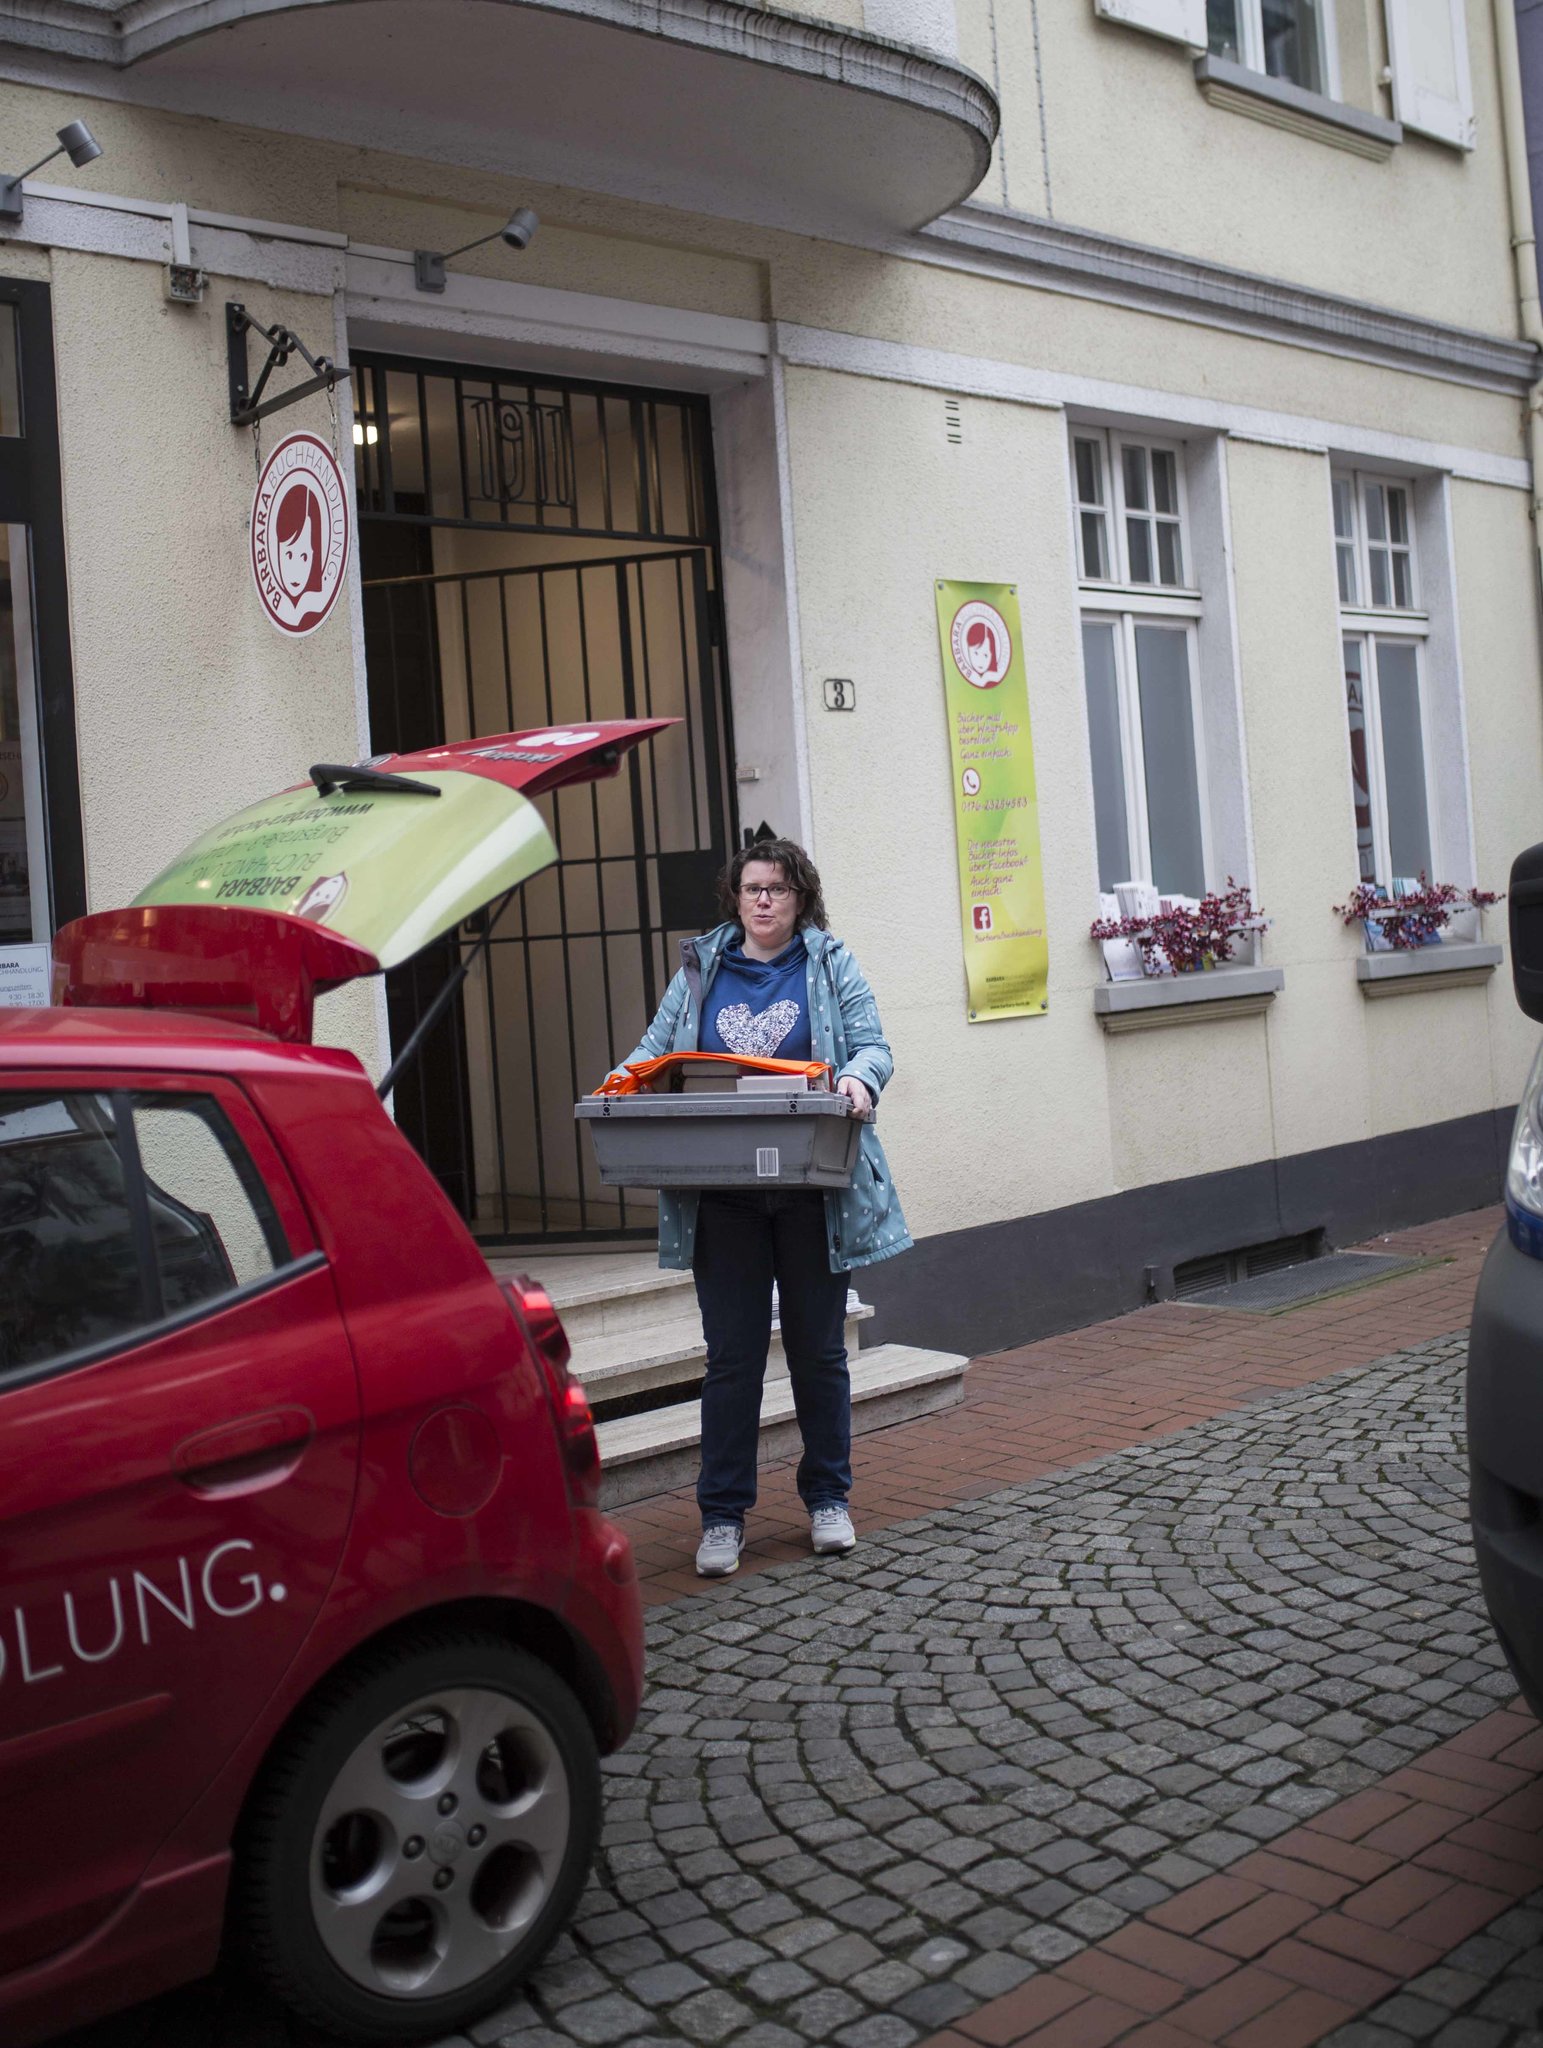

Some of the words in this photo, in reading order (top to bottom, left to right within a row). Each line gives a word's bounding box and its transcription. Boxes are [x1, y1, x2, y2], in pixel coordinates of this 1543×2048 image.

[256, 492, 282, 610] BARBARA
[834, 680, 845, 708] 3
[215, 876, 301, 898] BARBARA
[0, 1539, 287, 1683] LUNG.
